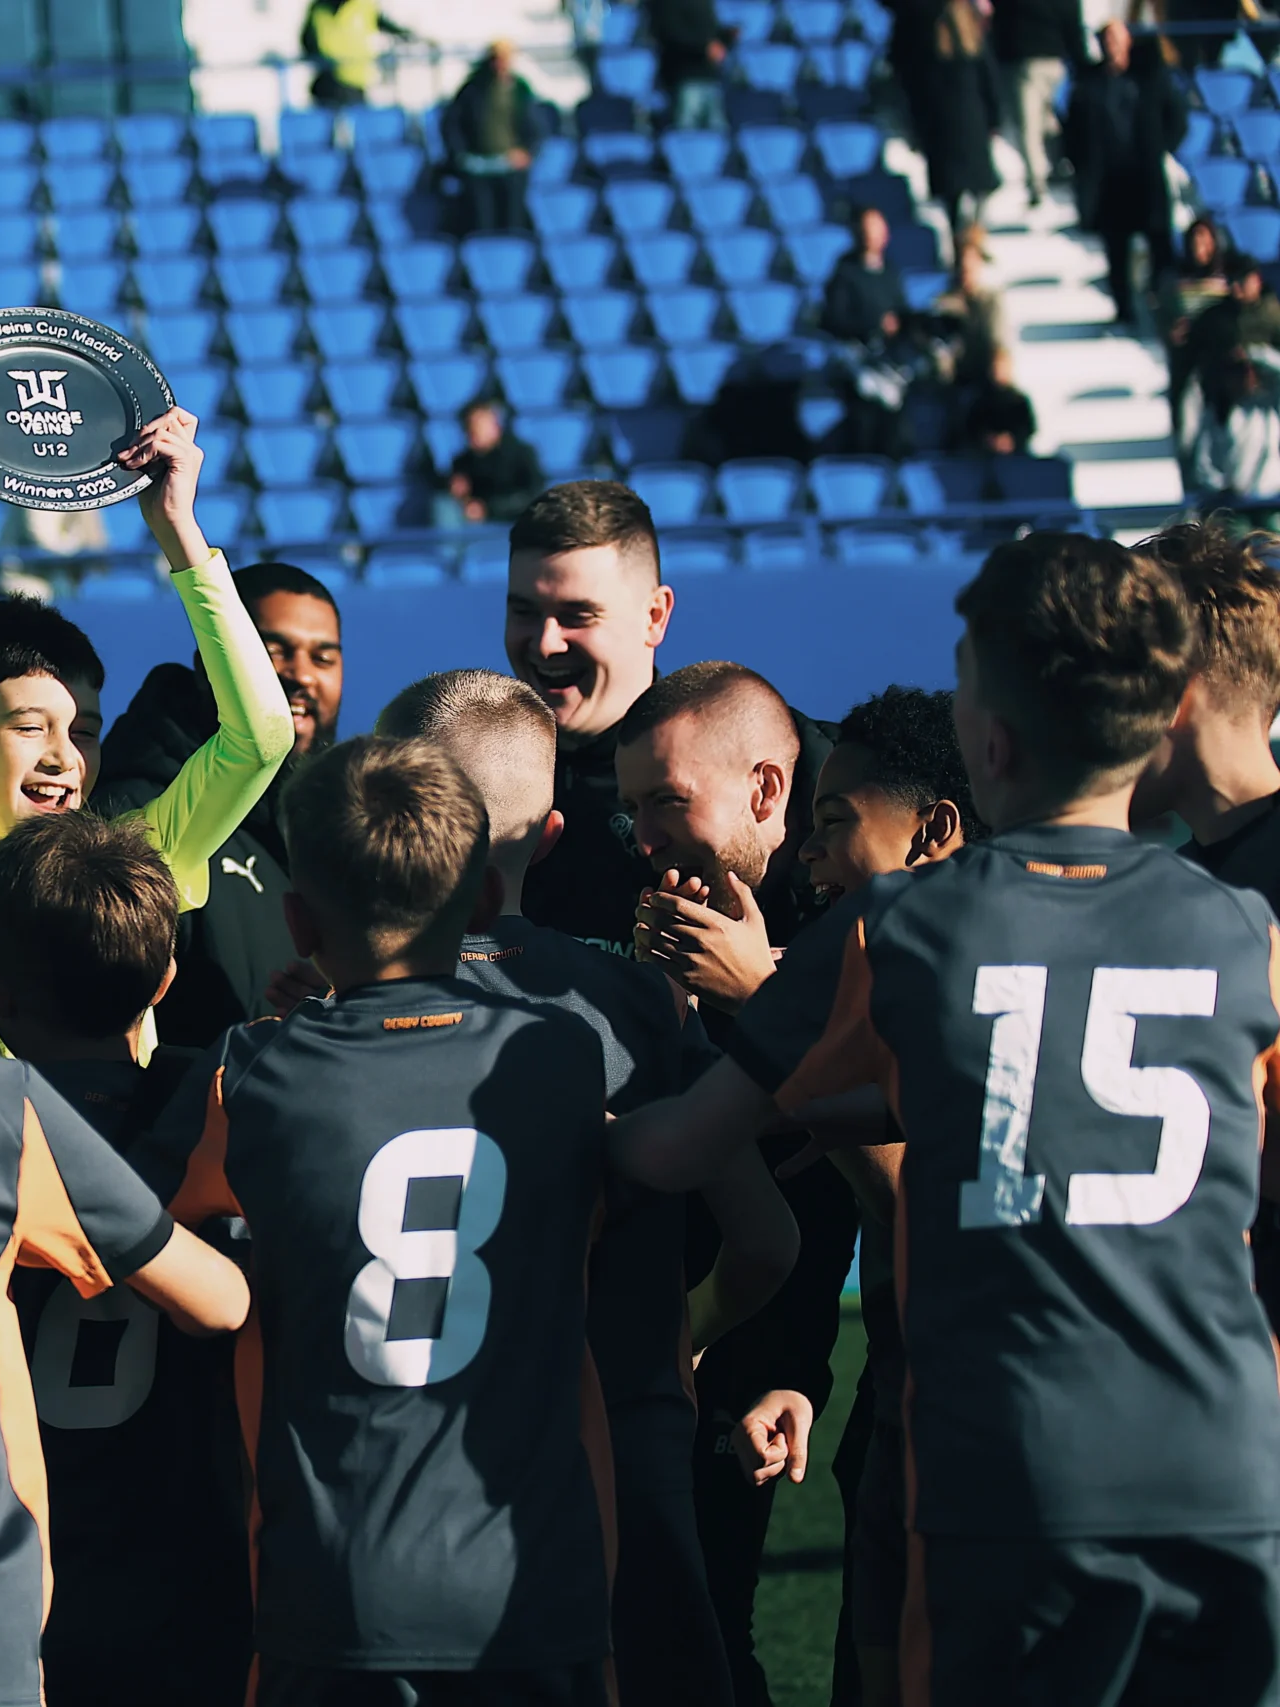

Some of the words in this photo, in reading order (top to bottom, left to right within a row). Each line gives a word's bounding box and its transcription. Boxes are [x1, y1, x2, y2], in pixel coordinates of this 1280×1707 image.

[36, 321, 68, 338] Cup
[71, 329, 123, 362] Madrid
[6, 410, 83, 424] ORANGE
[19, 421, 74, 436] VEINS
[33, 442, 68, 456] U12
[4, 475, 74, 499] Winners
[76, 476, 117, 498] 2025
[460, 952, 488, 962] DERBY
[489, 945, 524, 962] COUNTY
[959, 965, 1218, 1229] 15
[343, 1127, 508, 1387] 8
